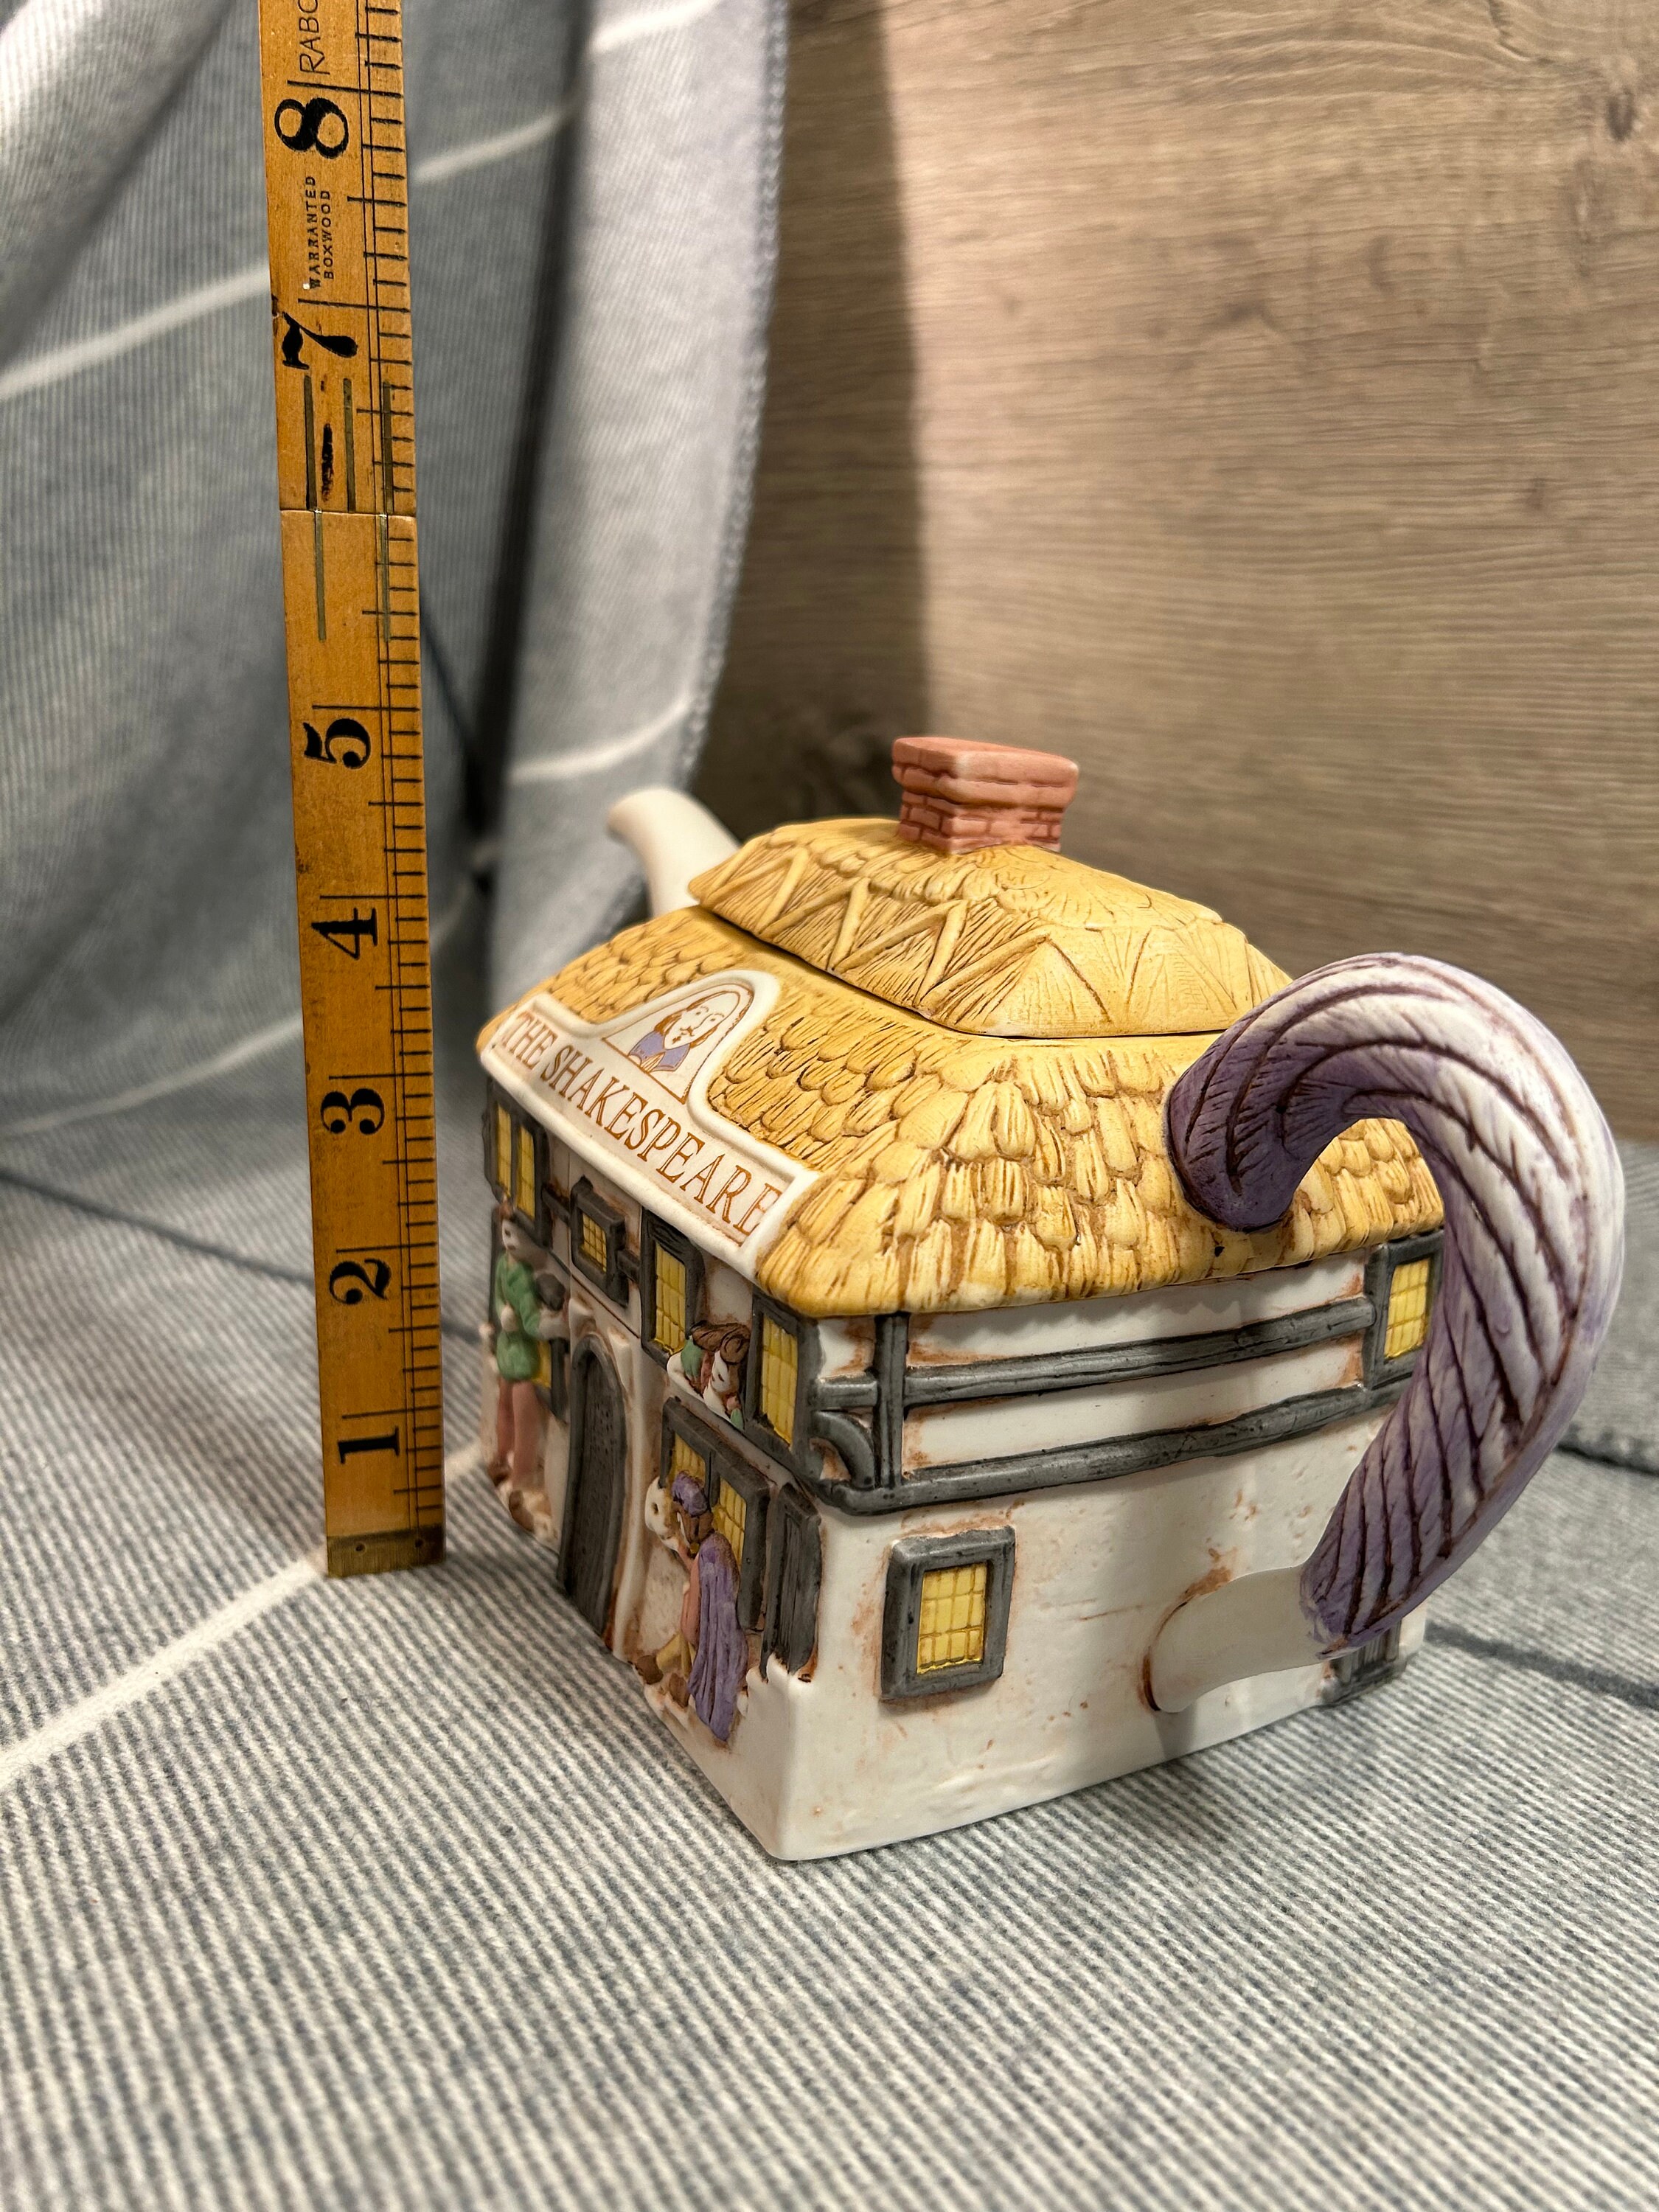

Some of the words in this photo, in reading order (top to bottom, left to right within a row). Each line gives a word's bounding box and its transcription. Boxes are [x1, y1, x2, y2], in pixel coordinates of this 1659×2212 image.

[274, 97, 349, 159] 8
[305, 176, 321, 289] WARRANTED
[321, 190, 334, 279] BOXWOOD
[282, 311, 358, 369] 7
[302, 718, 371, 769] 5
[310, 907, 378, 960] 4
[321, 1088, 385, 1135] 3
[500, 1009, 559, 1071] THE
[540, 1044, 784, 1237] SHAKESPEARE
[329, 1258, 392, 1305] 2
[337, 1425, 400, 1464] 1
